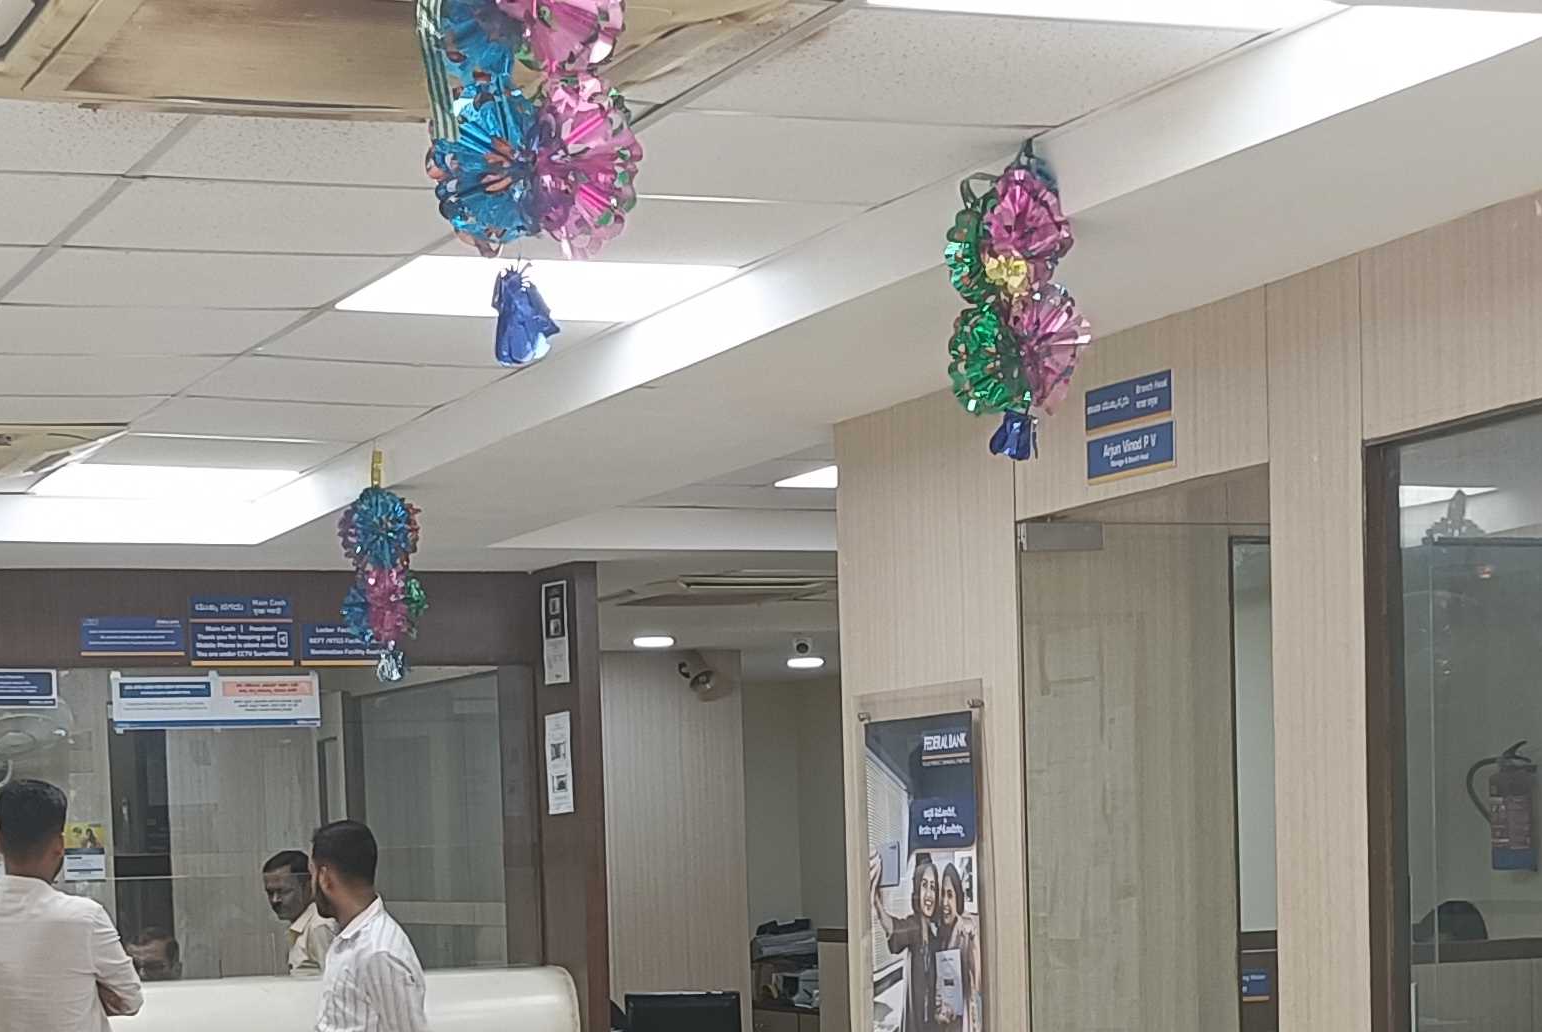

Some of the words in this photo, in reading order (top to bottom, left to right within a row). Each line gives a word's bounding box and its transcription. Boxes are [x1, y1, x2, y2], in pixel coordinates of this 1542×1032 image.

[1102, 442, 1121, 460] Arjun
[1122, 437, 1142, 454] Vinod
[1143, 436, 1150, 449] P
[1150, 433, 1157, 448] V
[269, 598, 287, 606] Cash
[238, 633, 261, 641] keeping
[923, 734, 948, 751] FEDERAL
